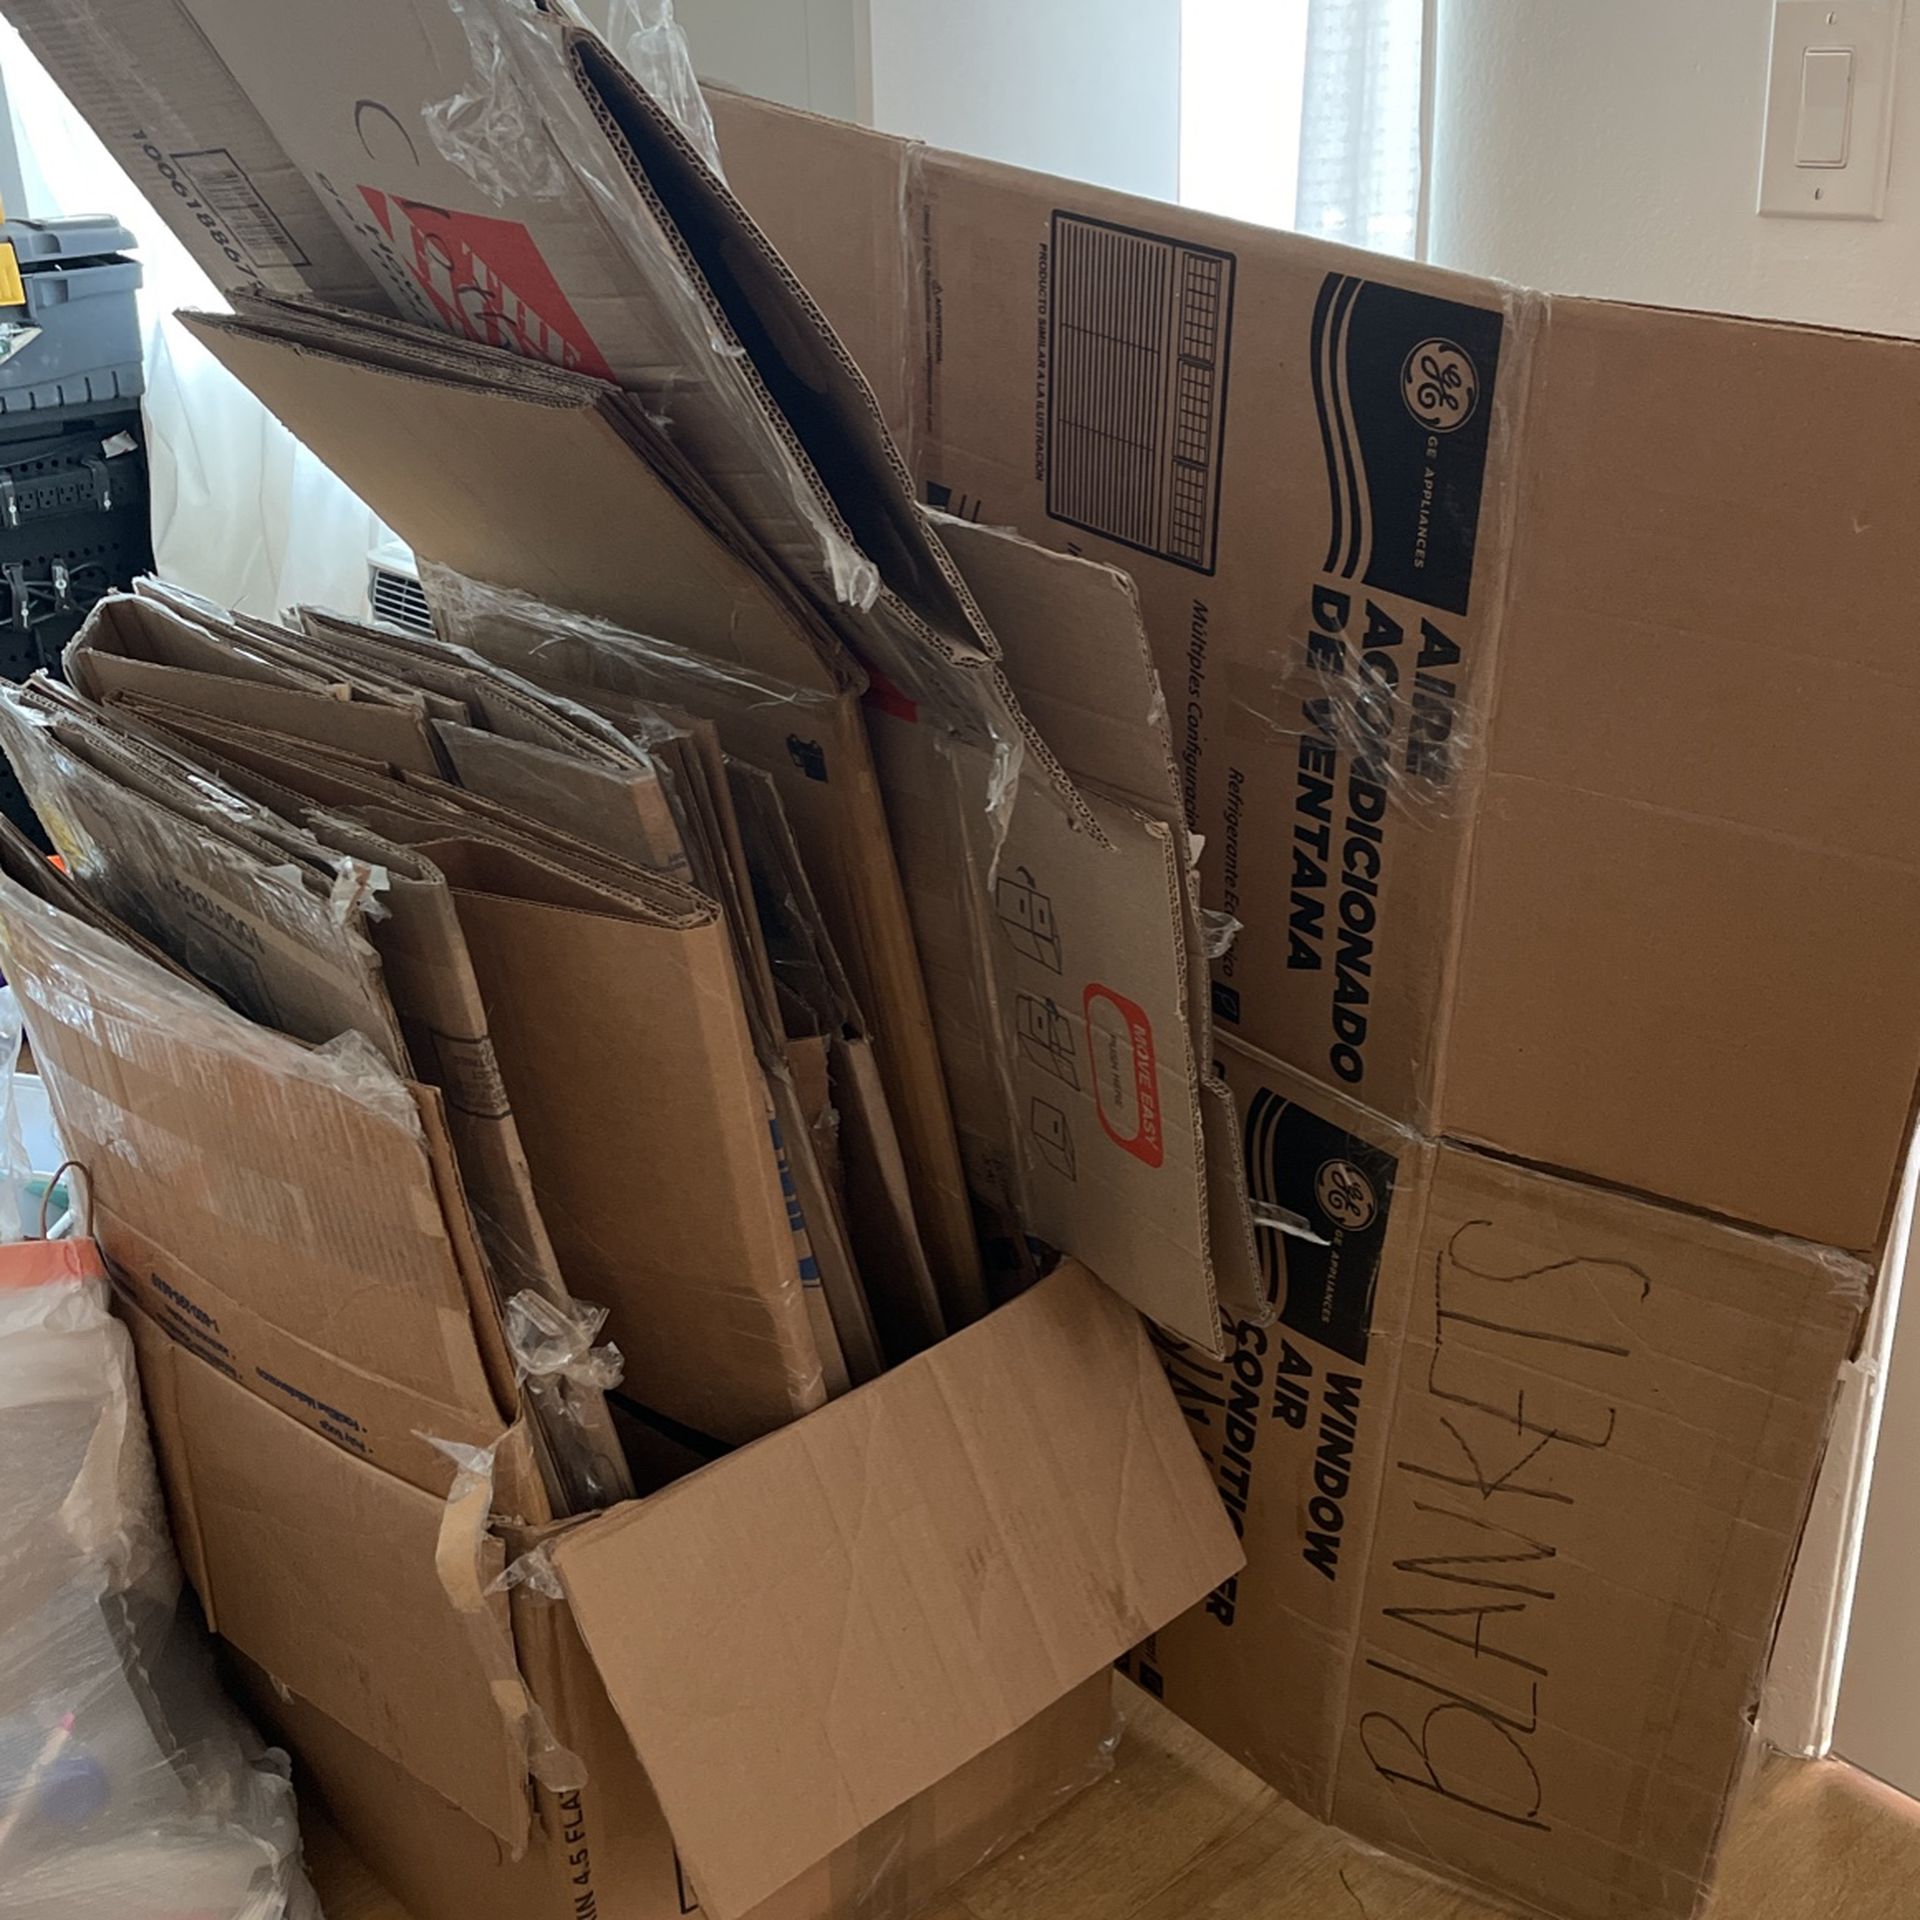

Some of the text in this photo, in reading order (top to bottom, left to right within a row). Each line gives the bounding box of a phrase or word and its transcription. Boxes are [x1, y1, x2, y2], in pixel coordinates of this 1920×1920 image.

[1036, 242, 1048, 315] PRODUCTO
[1035, 317, 1047, 369] SIMILAR
[1035, 381, 1045, 400] LA
[1411, 435, 1438, 569] GE APPLIANCES
[1182, 599, 1209, 836] Múltiples Configuracio
[1404, 617, 1461, 785] AIRE
[1219, 767, 1244, 885] Refrigerante
[1286, 584, 1352, 971] DE VENTANA
[1328, 600, 1404, 1085] ACONDICIONADO
[1131, 1023, 1158, 1152] MOVE EASY
[1319, 1250, 1340, 1324] APPLIANCES
[1271, 1338, 1312, 1430] AIR
[1302, 1370, 1362, 1581] WINDOW
[1359, 1219, 1652, 1833] BLANKETS
[558, 1790, 586, 1845] FLA
[569, 1847, 591, 1886] 4.5
